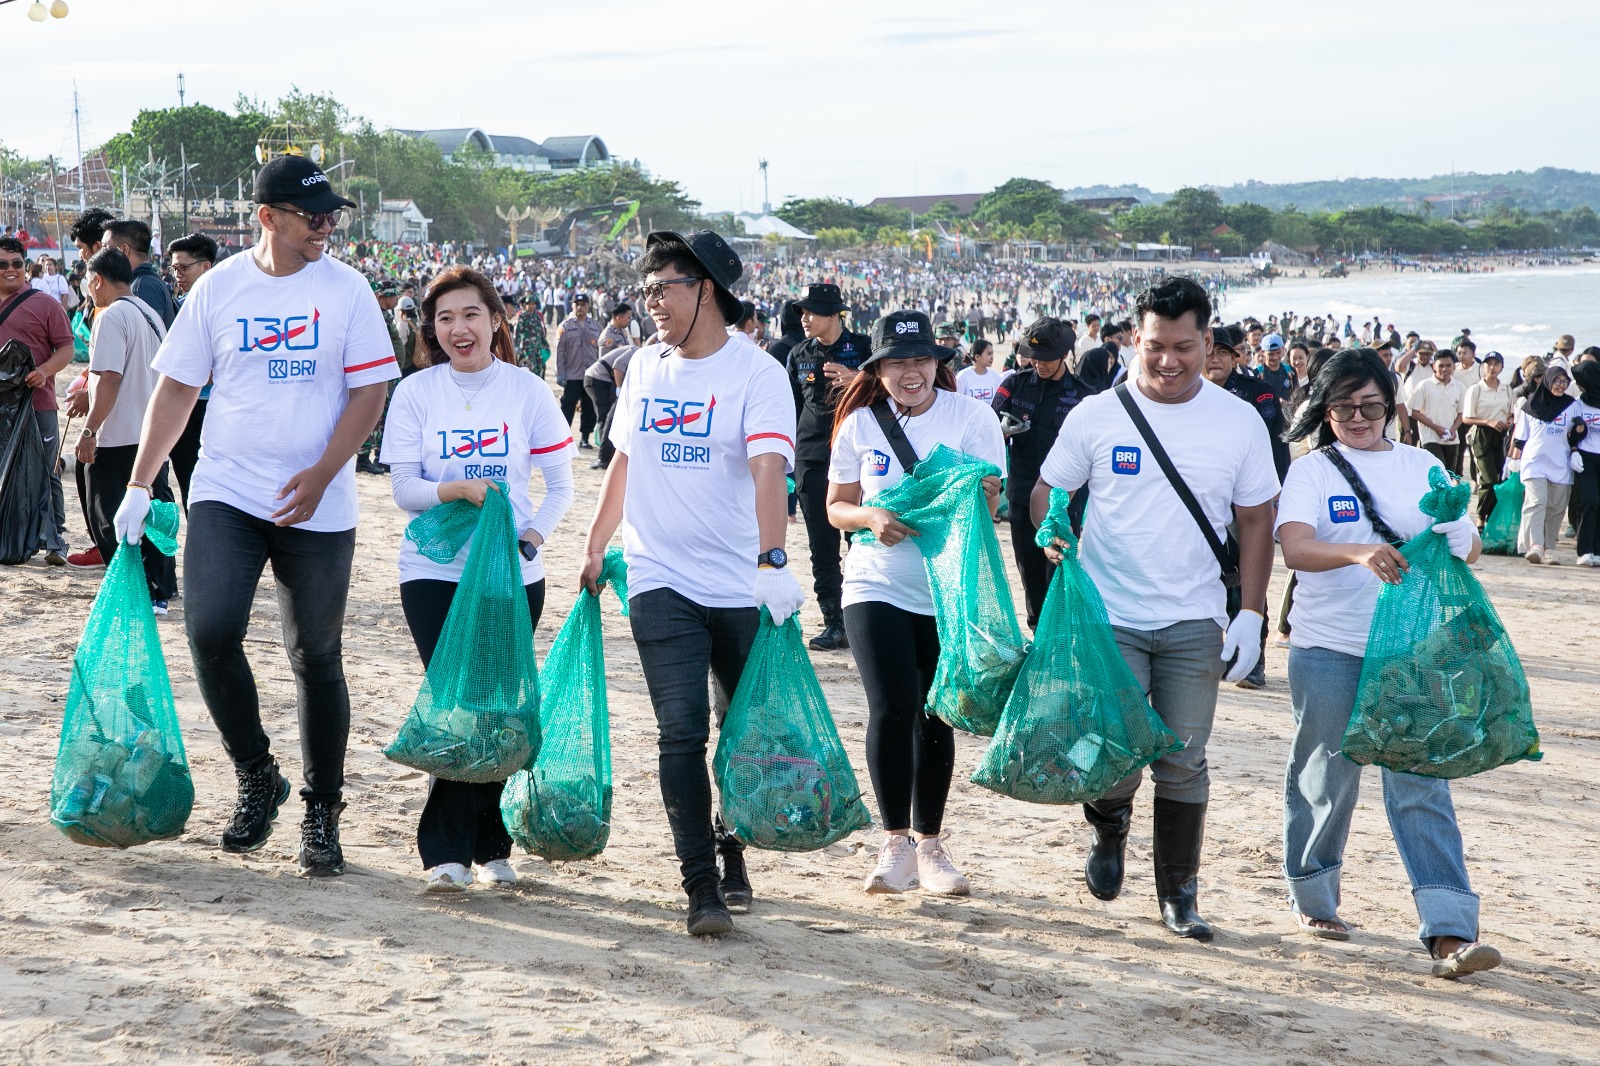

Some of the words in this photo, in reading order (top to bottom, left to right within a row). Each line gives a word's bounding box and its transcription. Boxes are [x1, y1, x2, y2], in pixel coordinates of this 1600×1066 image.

[237, 307, 320, 352] 130
[906, 321, 918, 329] BRI
[290, 360, 316, 376] BRI
[638, 393, 716, 437] 130
[437, 420, 509, 459] 130
[683, 446, 709, 462] BRI
[869, 455, 886, 465] BRI
[1115, 451, 1137, 463] BRI
[483, 464, 507, 477] BRI
[1118, 462, 1137, 470] mo
[1332, 500, 1355, 511] BRI
[1337, 510, 1357, 518] mo
